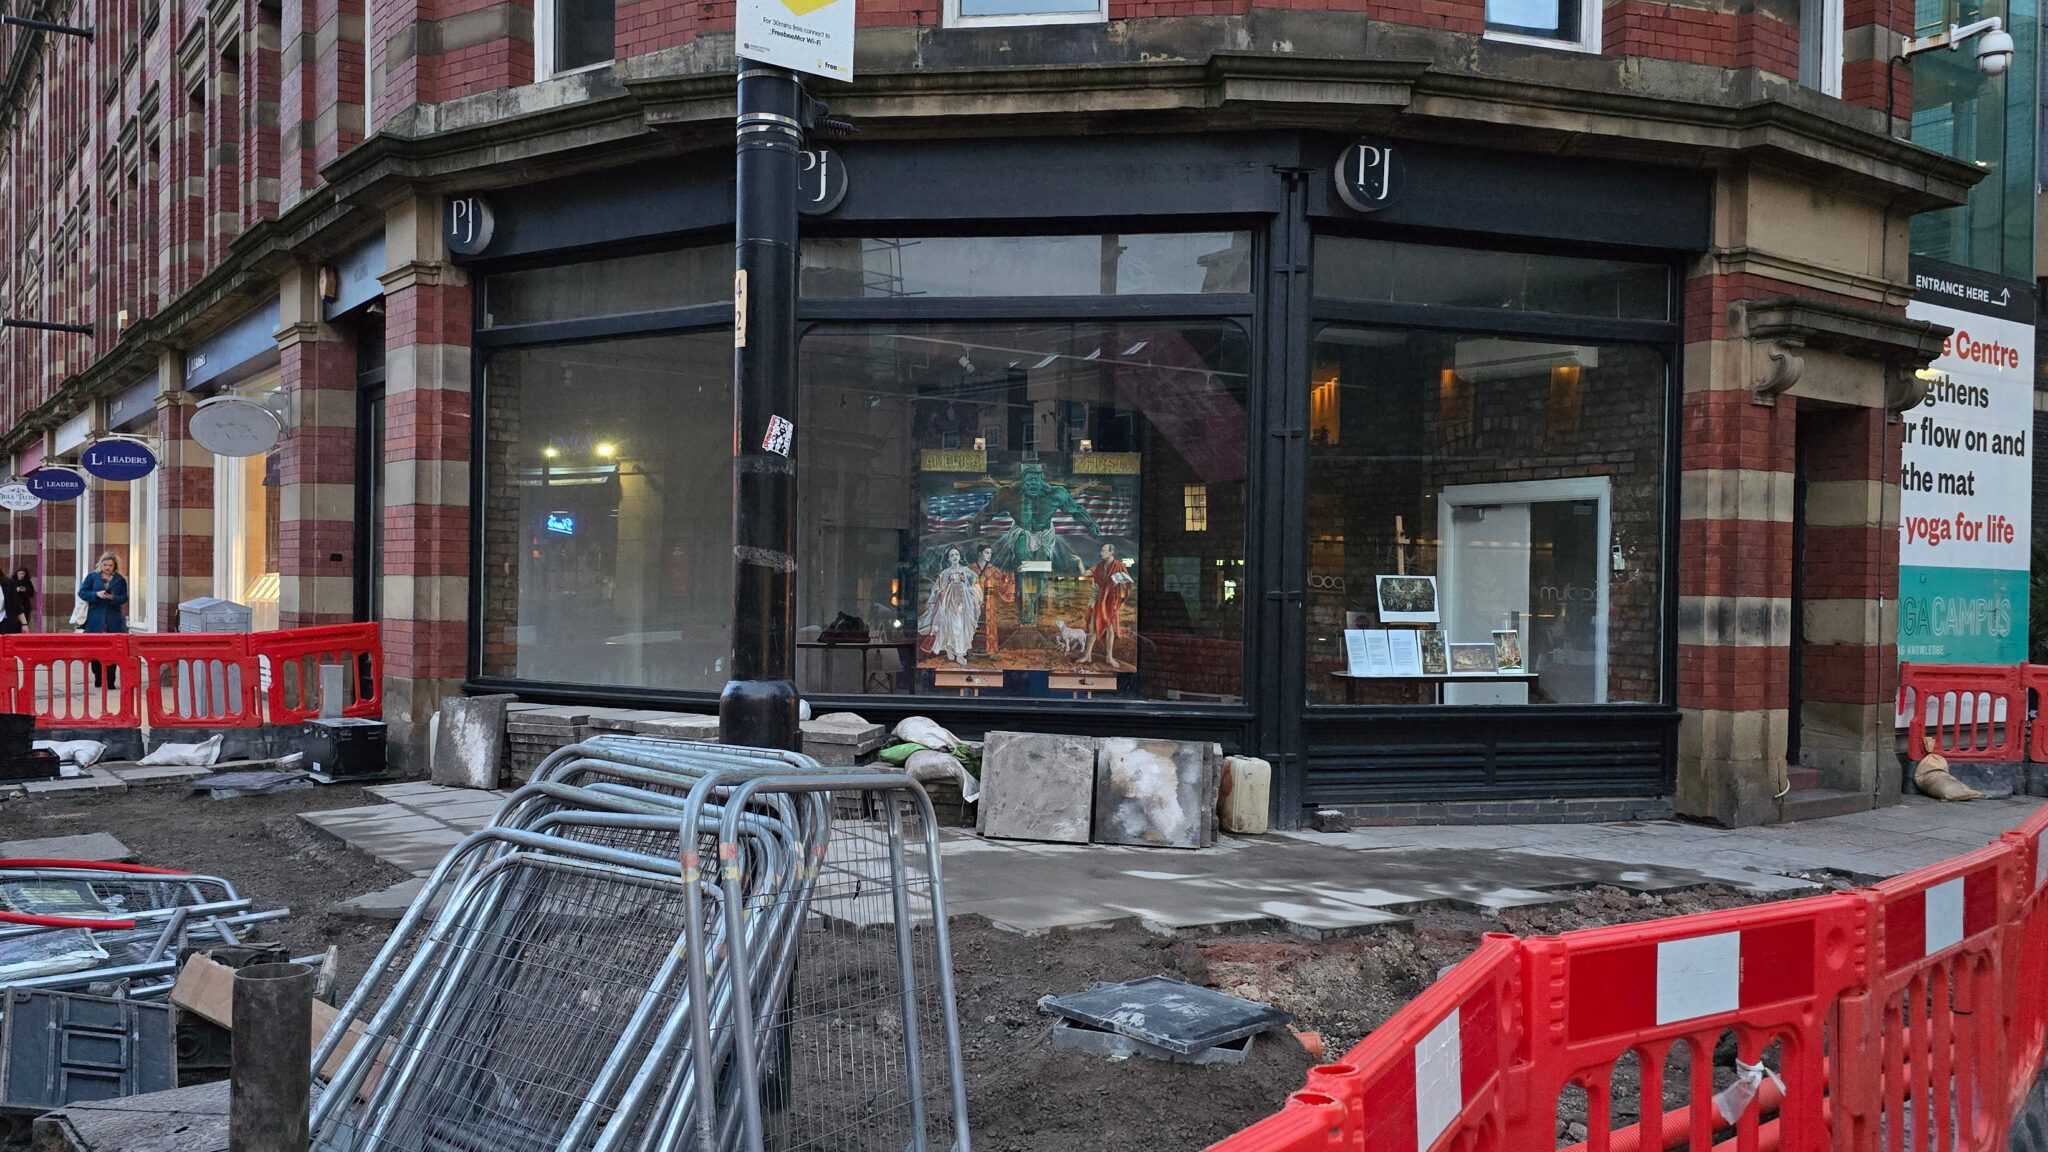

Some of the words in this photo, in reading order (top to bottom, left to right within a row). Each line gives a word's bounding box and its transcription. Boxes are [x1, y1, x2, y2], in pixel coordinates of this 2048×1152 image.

[771, 28, 805, 42] FreebeeMcr
[806, 37, 822, 46] Wi-Fi
[792, 24, 803, 32] free
[804, 27, 824, 37] connect
[1357, 144, 1393, 200] PJ
[452, 197, 473, 244] PJ
[1915, 274, 1965, 297] ENTRANCE
[1966, 286, 1990, 303] HERE
[1956, 331, 2018, 369] Centre
[1921, 416, 1961, 449] flow
[1965, 430, 1987, 452] on
[1992, 430, 2025, 457] and
[92, 453, 103, 466] L
[107, 455, 148, 465] LEADERS
[34, 479, 43, 490] L
[1901, 462, 1933, 492] the
[1938, 471, 1975, 496] mat
[1905, 516, 1952, 546] yoga
[1955, 512, 1983, 541] for
[1987, 514, 2014, 544] life
[1907, 645, 1945, 656] KNOWLEDGE
